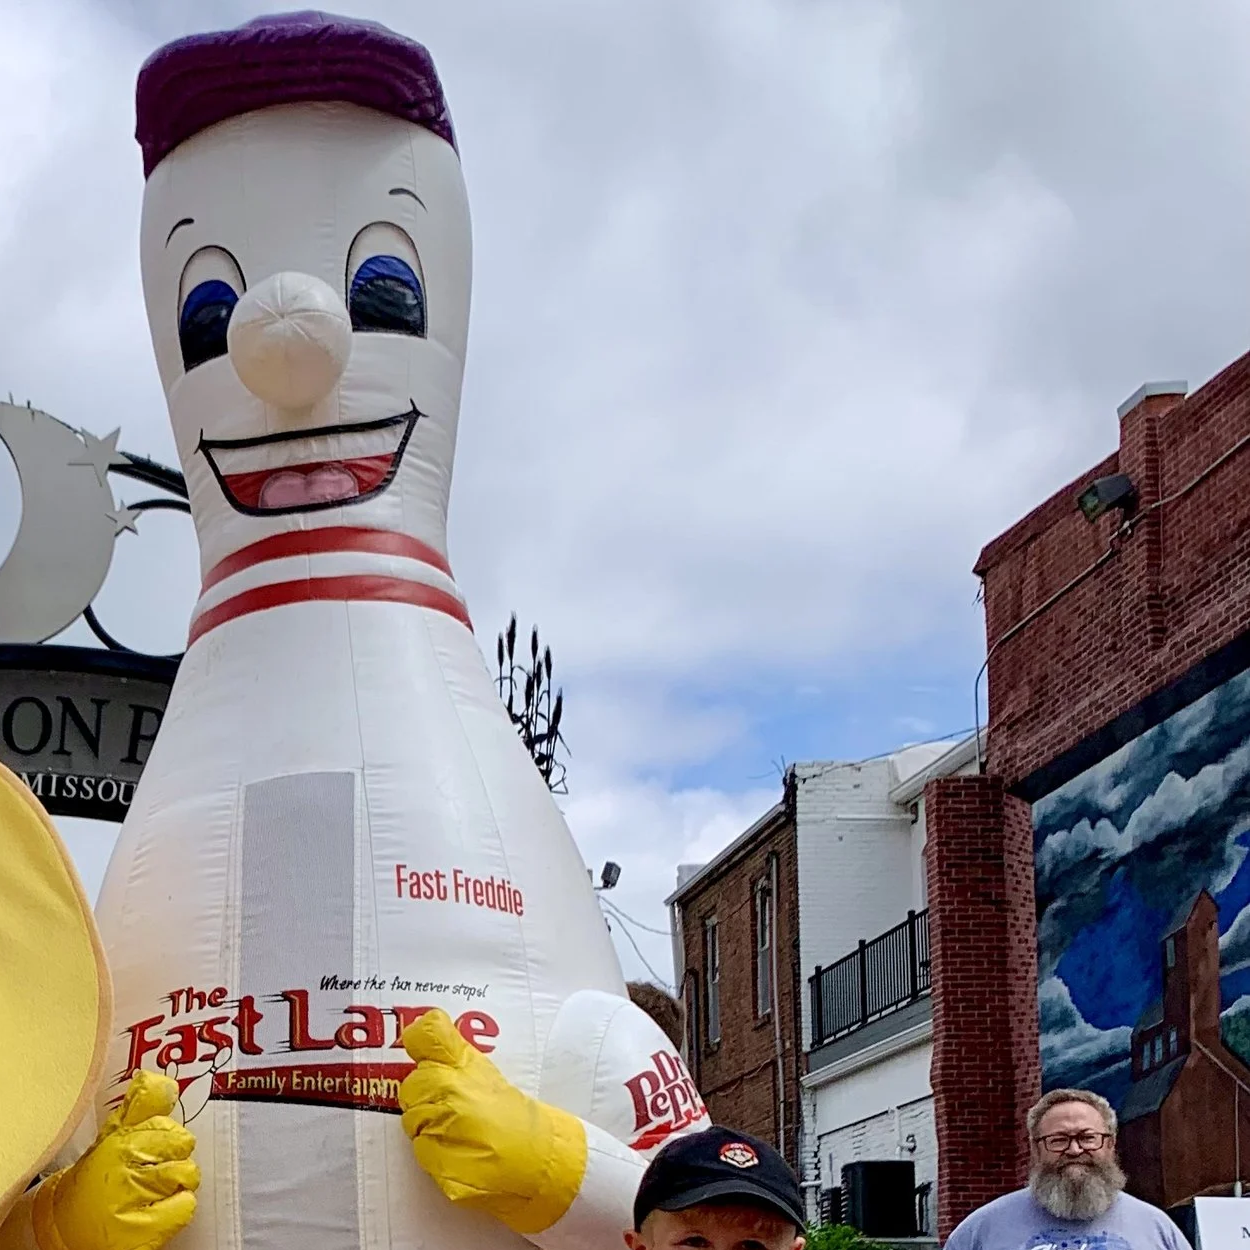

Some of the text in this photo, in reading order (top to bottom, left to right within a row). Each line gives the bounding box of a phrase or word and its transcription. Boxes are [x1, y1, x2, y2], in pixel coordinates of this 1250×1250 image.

[21, 772, 137, 805] MISSOU
[395, 863, 524, 917] Fast Freddie
[168, 986, 229, 1018] The
[319, 974, 489, 1001] Where the fun never stops!
[118, 995, 265, 1083] Fast
[227, 1070, 401, 1099] Family Entertainm
[623, 1070, 699, 1132] Pepp
